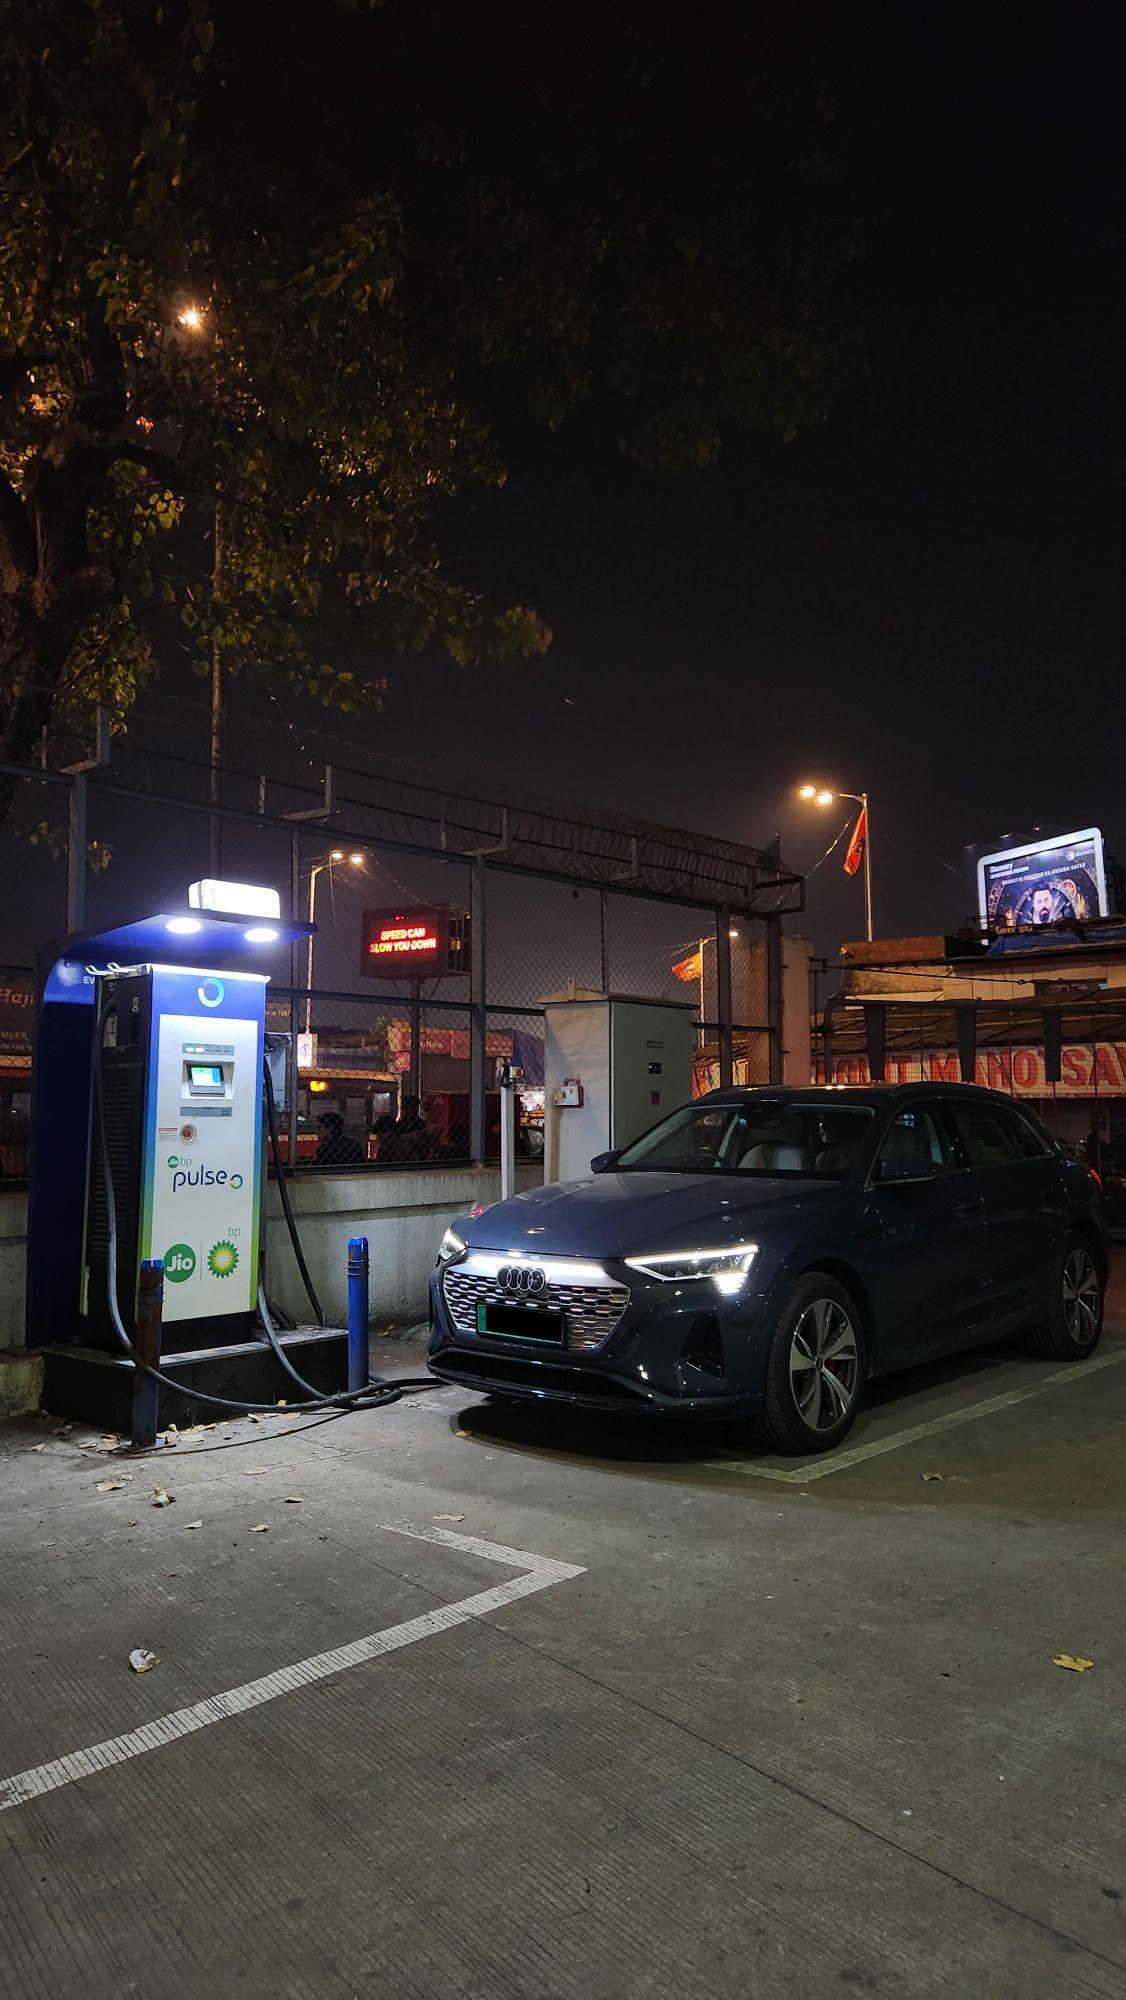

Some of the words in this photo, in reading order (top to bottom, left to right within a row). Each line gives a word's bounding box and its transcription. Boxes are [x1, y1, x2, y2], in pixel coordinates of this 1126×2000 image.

[381, 930, 406, 941] SPEED
[407, 927, 426, 939] CAN
[370, 942, 393, 953] SLOW
[393, 940, 411, 951] YOU
[411, 938, 437, 950] DOWN
[180, 1156, 192, 1167] bp
[173, 1164, 228, 1192] pulse
[228, 1226, 241, 1238] bp
[166, 1253, 194, 1272] Jio
